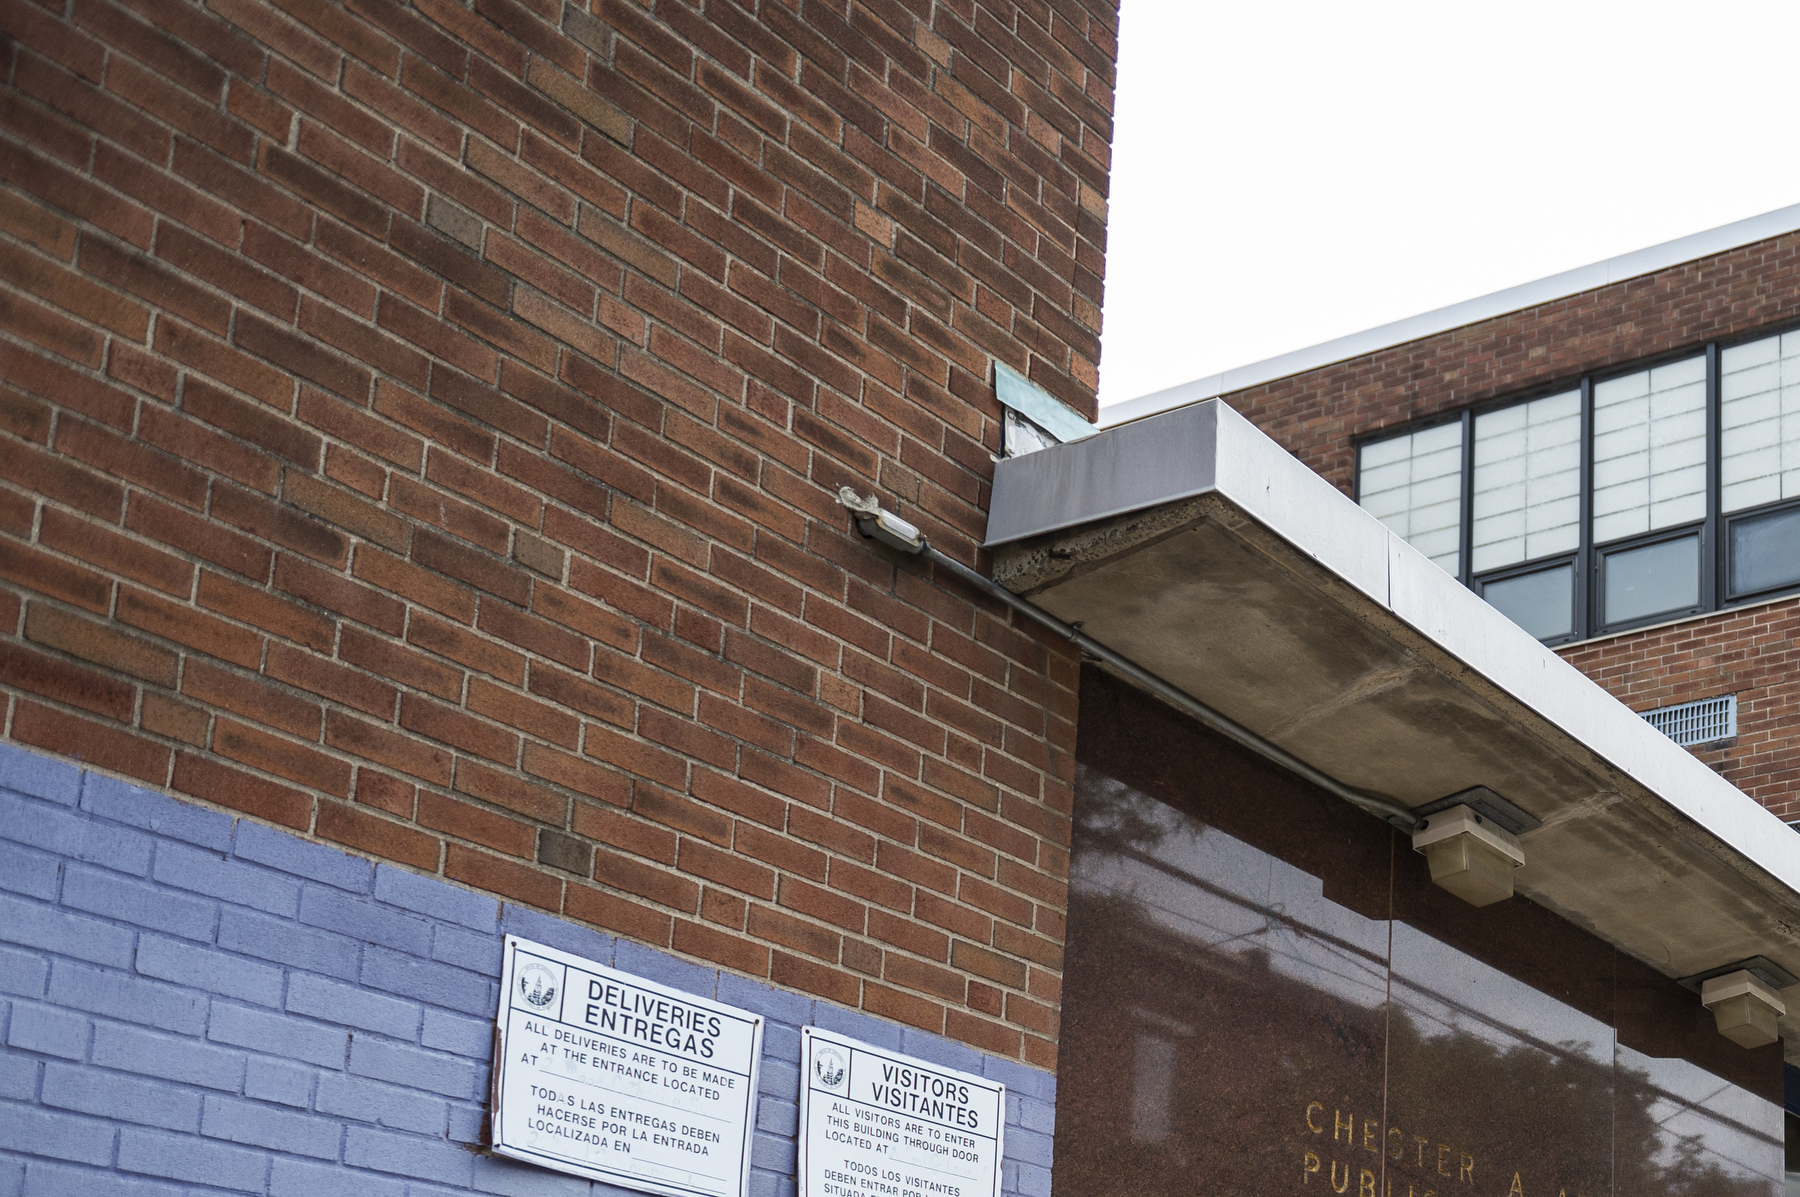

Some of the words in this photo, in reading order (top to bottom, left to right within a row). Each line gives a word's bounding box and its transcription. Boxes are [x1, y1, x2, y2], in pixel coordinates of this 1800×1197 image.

[585, 1003, 715, 1059] ENTREGAS
[588, 979, 721, 1038] DELIVERIES
[521, 1052, 539, 1066] AT
[524, 1020, 549, 1037] ALL
[554, 1029, 627, 1059] DELIVERIES
[632, 1051, 656, 1068] ARE
[662, 1059, 678, 1073] TO
[683, 1065, 698, 1079] BE
[702, 1071, 735, 1090] MADE
[540, 1042, 556, 1055] AT
[563, 1048, 587, 1064] THE
[592, 1056, 658, 1084] ENTRANCE
[663, 1077, 721, 1101] LOCATED
[872, 1082, 979, 1129] VISITANTES
[882, 1063, 970, 1105] VISITORS
[528, 1117, 609, 1149] LOCALIZADA
[614, 1140, 631, 1154] EN
[530, 1085, 575, 1107] TODAS
[580, 1098, 605, 1115] LAS
[610, 1107, 677, 1133] ENTREGAS
[681, 1125, 721, 1144] DEBEN
[537, 1104, 596, 1129] HACERSE
[601, 1121, 628, 1137] POR
[632, 1128, 648, 1142] LA
[653, 1134, 709, 1157] ENTRADA
[831, 1102, 850, 1116] ALL
[855, 1107, 901, 1130] VISITORS
[904, 1122, 923, 1136] ARE
[928, 1128, 941, 1140] TO
[944, 1133, 976, 1149] ENTER
[825, 1129, 872, 1151] LOCATED
[875, 1143, 889, 1155] AT
[826, 1114, 850, 1130] THIS
[854, 1122, 899, 1143] BUILDING
[903, 1135, 949, 1157] THROUGH
[952, 1147, 980, 1164] DOOR
[1305, 1100, 1476, 1186] CHESTER
[824, 1168, 857, 1186] DEBEN
[860, 1178, 899, 1197] ENTRAR
[844, 1159, 878, 1177] TODOS
[882, 1169, 901, 1183] LOS
[905, 1175, 961, 1197] VISITANTES
